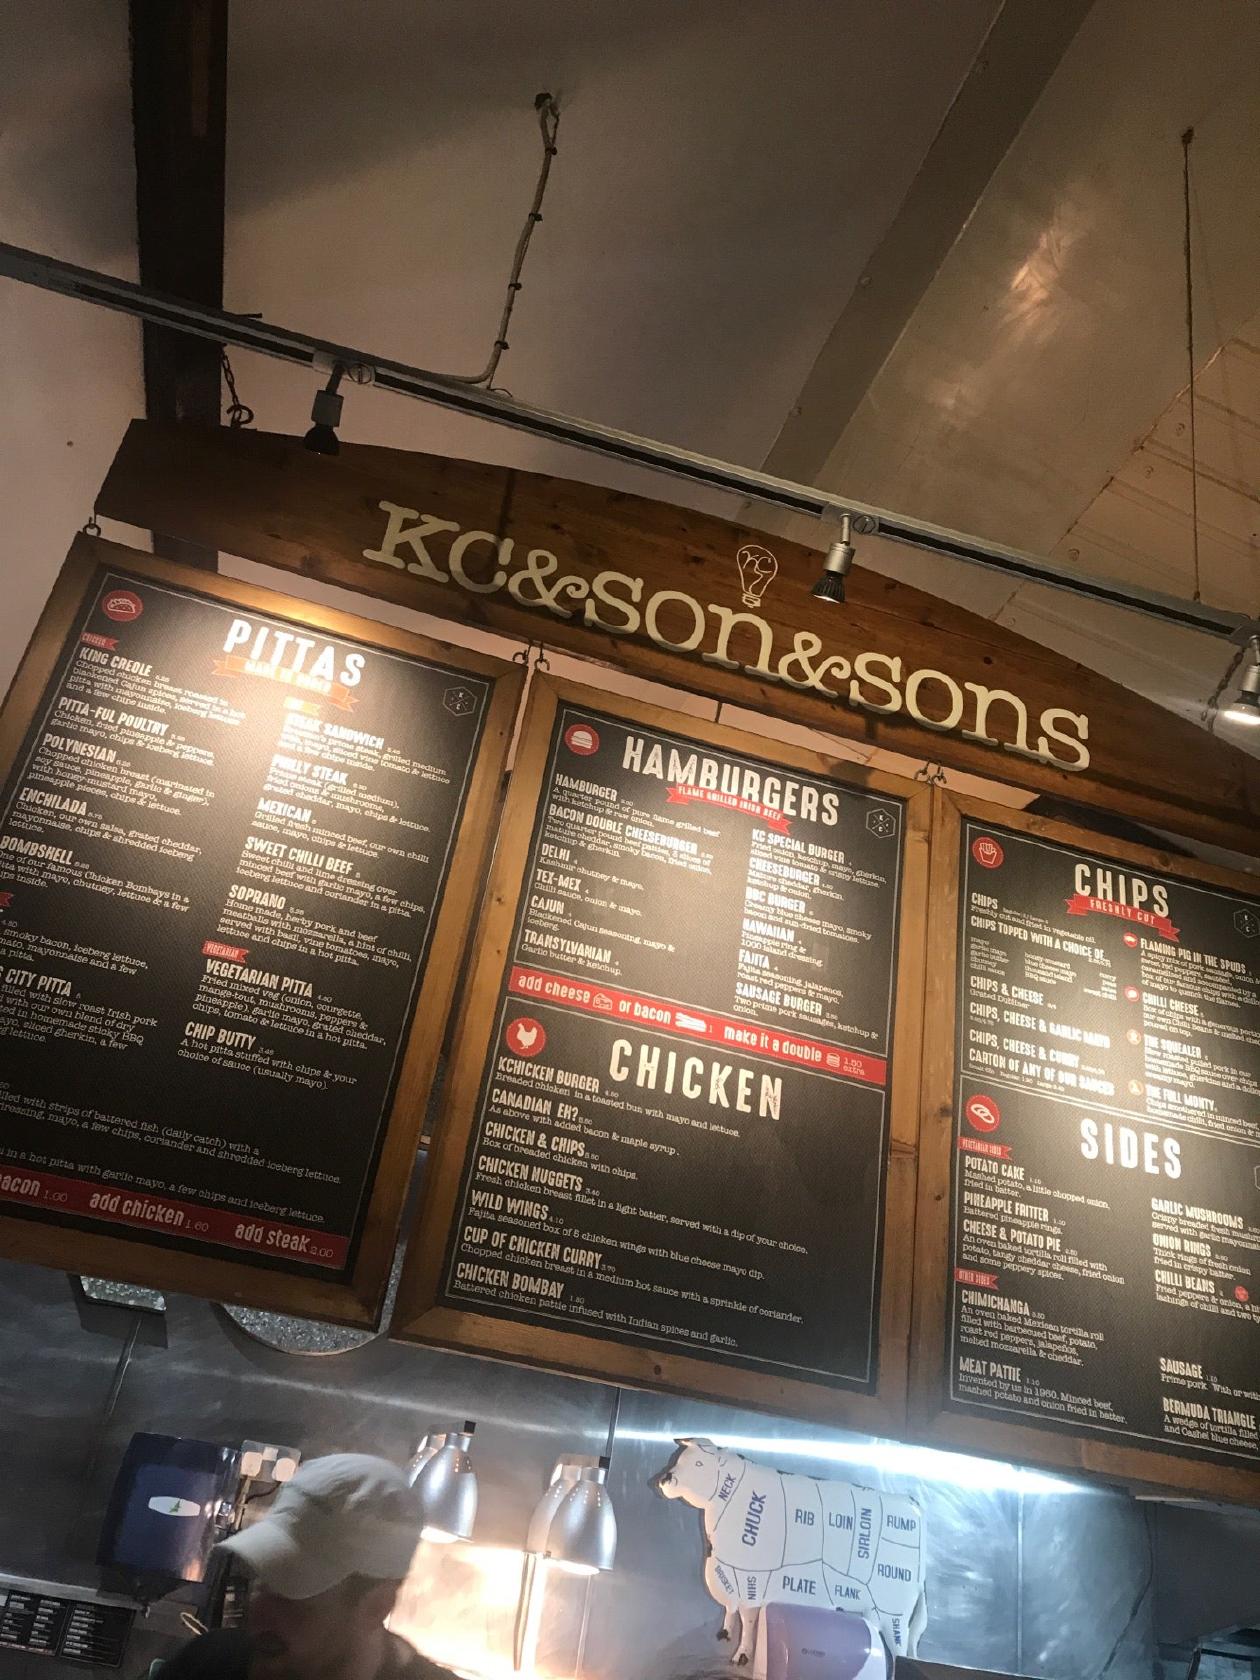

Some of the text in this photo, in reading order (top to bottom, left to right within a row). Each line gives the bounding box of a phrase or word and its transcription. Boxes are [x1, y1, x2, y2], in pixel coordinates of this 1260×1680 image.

[79, 646, 152, 677] KING CREOLE
[222, 617, 367, 689] PITTAS
[58, 696, 169, 736] PITTA-FUL POULTRY
[42, 732, 117, 763] POLYNESIAN
[555, 773, 617, 801] HAMBURGER
[621, 735, 840, 827] HAMBURGERS
[677, 784, 703, 799] FLAME
[706, 791, 737, 806] GRILLED
[19, 787, 88, 816] ENCHILADA
[257, 796, 311, 823] MEXICAN
[548, 804, 698, 854] BACON DOUBLE CHEESEBURGER
[0, 836, 73, 865] BOMBSHELL
[244, 835, 353, 875] SWEET CHILLI BEEF
[540, 843, 570, 861] DELHI
[751, 828, 844, 864] KC SPECIAL BURGER
[535, 868, 581, 891] TEX-MEX
[748, 856, 819, 886] CHEESEBURGER
[228, 883, 286, 911] SOPRANO
[530, 895, 564, 914] CAJUN
[971, 892, 997, 909] CHIPS
[1074, 862, 1168, 918] CHIPS
[1090, 898, 1154, 924] FRESHLY CUT
[742, 917, 794, 942] HAWAIIAN
[971, 915, 1091, 957] CHIPS TOPPED WITH A CHOICE
[523, 929, 611, 963] TRANSYLVANIAN
[738, 948, 770, 969] FAJITA
[1140, 938, 1245, 974] FLAMING PIG IN THE SPUDS
[4, 967, 73, 996] CITY PITTA
[204, 959, 314, 998] VEGETARIAN PITTA
[970, 975, 1043, 1005] CHIPS & CHEESE
[735, 981, 822, 1016] SAUSAGE BURGER
[1142, 991, 1198, 1016] CHILLI CHEESE
[517, 972, 822, 1062] add cheese or bacon make it a double
[970, 1001, 1046, 1033] CHIPS, CHEESE &
[184, 1020, 256, 1050] CHIP BUTTY
[497, 1056, 600, 1093] KCHICKEN BURGER
[607, 1036, 783, 1120] CHICKEN
[490, 1088, 578, 1122] CANADIAN EH?
[484, 1121, 585, 1157] CHICKEN & CHIPS
[1080, 1117, 1181, 1179] SIDES
[477, 1154, 583, 1191] CHICKEN NUGGETS
[965, 1155, 1024, 1181] POTATO CAKE
[88, 1190, 185, 1226] add chicken
[469, 1189, 549, 1220] WILD WINGS
[964, 1191, 1048, 1222] PINEAPPLE FRITTER
[1151, 1197, 1243, 1229] GARLIC MUSHROOMS
[234, 1220, 310, 1253] add steak
[462, 1224, 602, 1269] CUP OF CHICKEN CURRY
[963, 1218, 1060, 1251] CHEESE & POTATO PIE
[1152, 1232, 1210, 1257] ONION RINGS
[455, 1262, 564, 1299] CHICKEN BOMBAY
[1155, 1269, 1214, 1294] CHILLI BEANS
[961, 1289, 1029, 1315] CHIMICHANGA
[959, 1356, 1021, 1382] MEAT PATTIE
[1160, 1357, 1203, 1379] SAUSAGE
[1163, 1397, 1255, 1429] BERMUDA TRIANGLE
[718, 1473, 737, 1501] NECK
[741, 1491, 767, 1547] CHUCK
[794, 1508, 815, 1527] RIB
[828, 1512, 854, 1531] LOIN
[886, 1515, 917, 1532] RUMP
[857, 1508, 873, 1560] SIRLOIN
[746, 1576, 758, 1601] SHIN
[782, 1575, 817, 1596] PLATE
[877, 1563, 912, 1583] ROUND
[834, 1584, 862, 1600] FLANK
